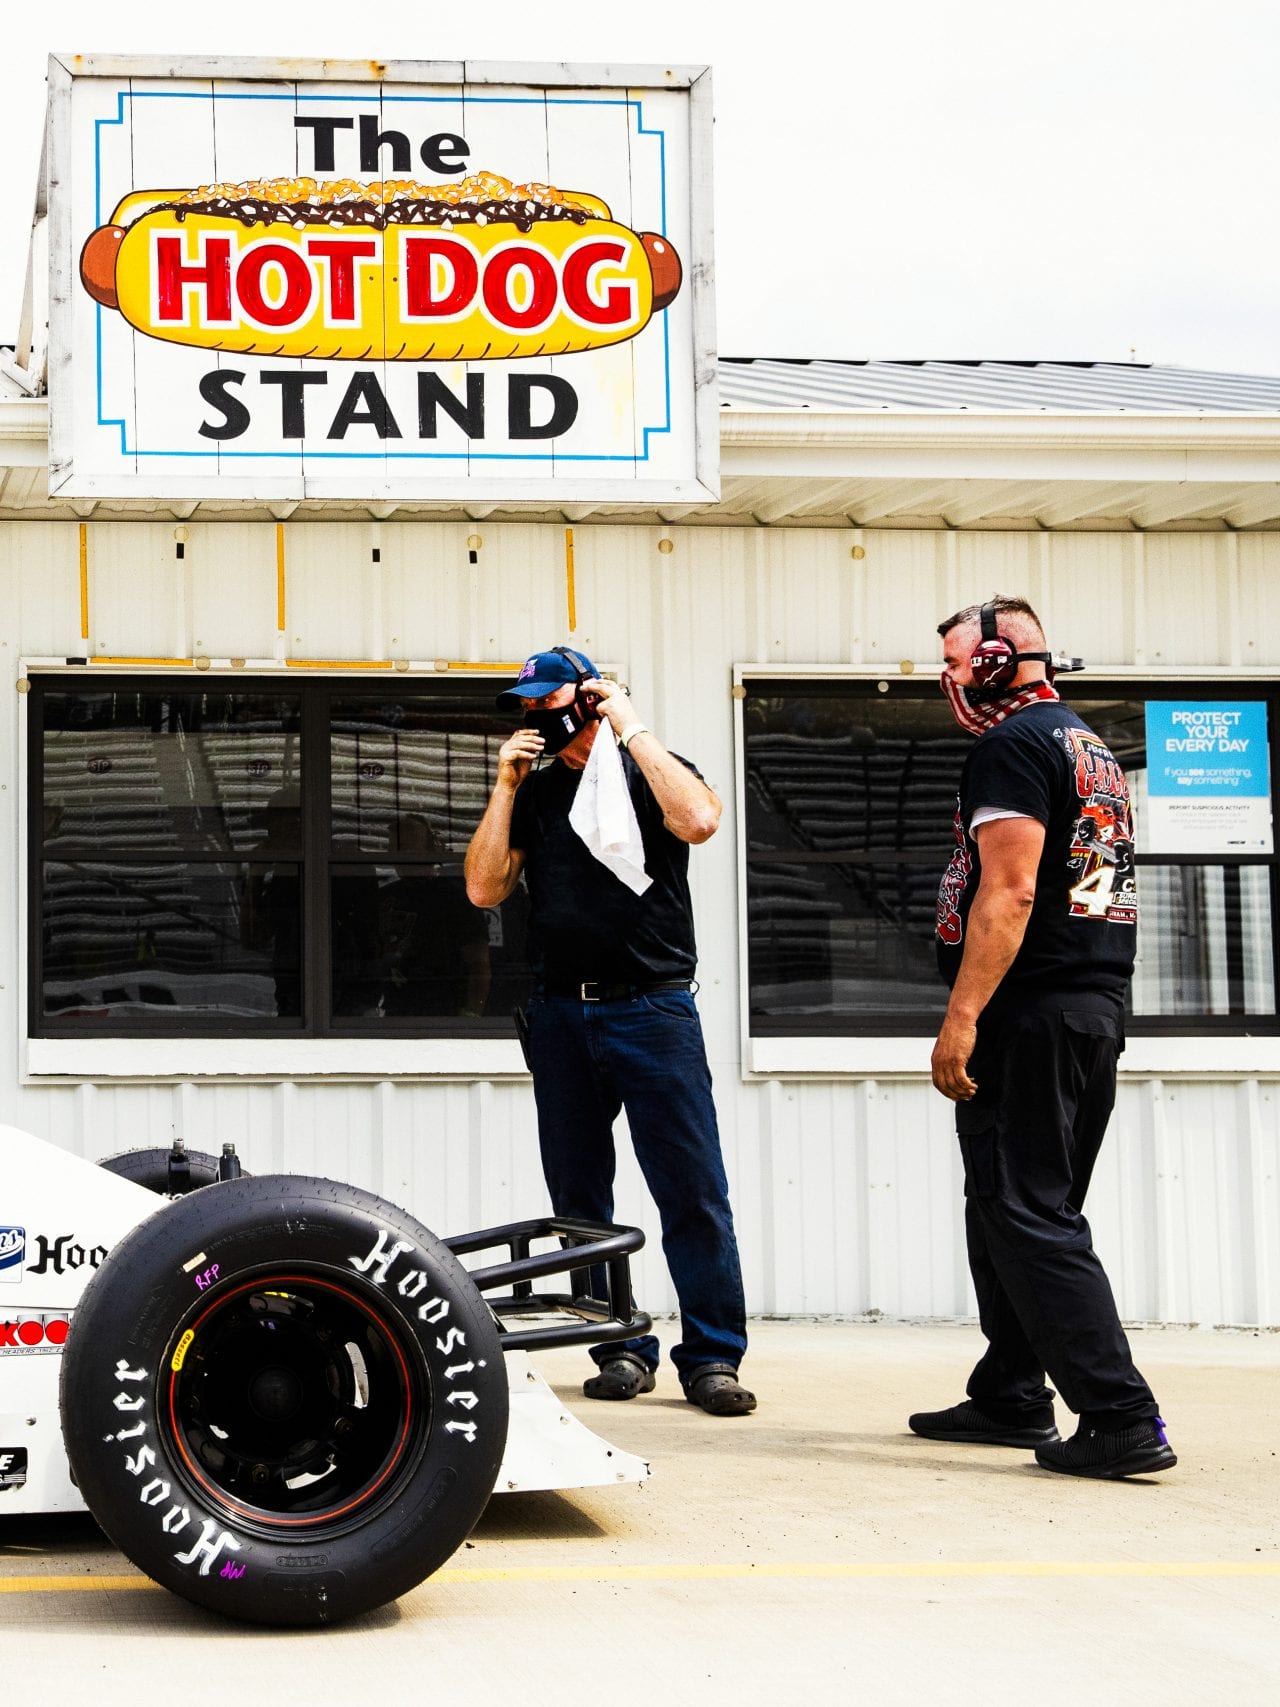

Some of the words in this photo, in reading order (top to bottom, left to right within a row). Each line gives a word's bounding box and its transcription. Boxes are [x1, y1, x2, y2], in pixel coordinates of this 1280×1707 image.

[294, 114, 470, 175] The
[154, 234, 379, 330] HOT
[402, 234, 634, 331] DOG
[198, 369, 579, 441] STAND
[1172, 712, 1242, 726] PROTECT
[1186, 726, 1229, 739] YOUR
[1165, 739, 1216, 752] EVERY
[1219, 739, 1250, 753] DAY
[1171, 769, 1188, 778] you
[1177, 777, 1193, 786] say
[1070, 865, 1116, 916] 4
[27, 1233, 109, 1275] Hoo
[347, 1229, 488, 1444] Hoosier
[102, 1358, 242, 1577] Hoosier
